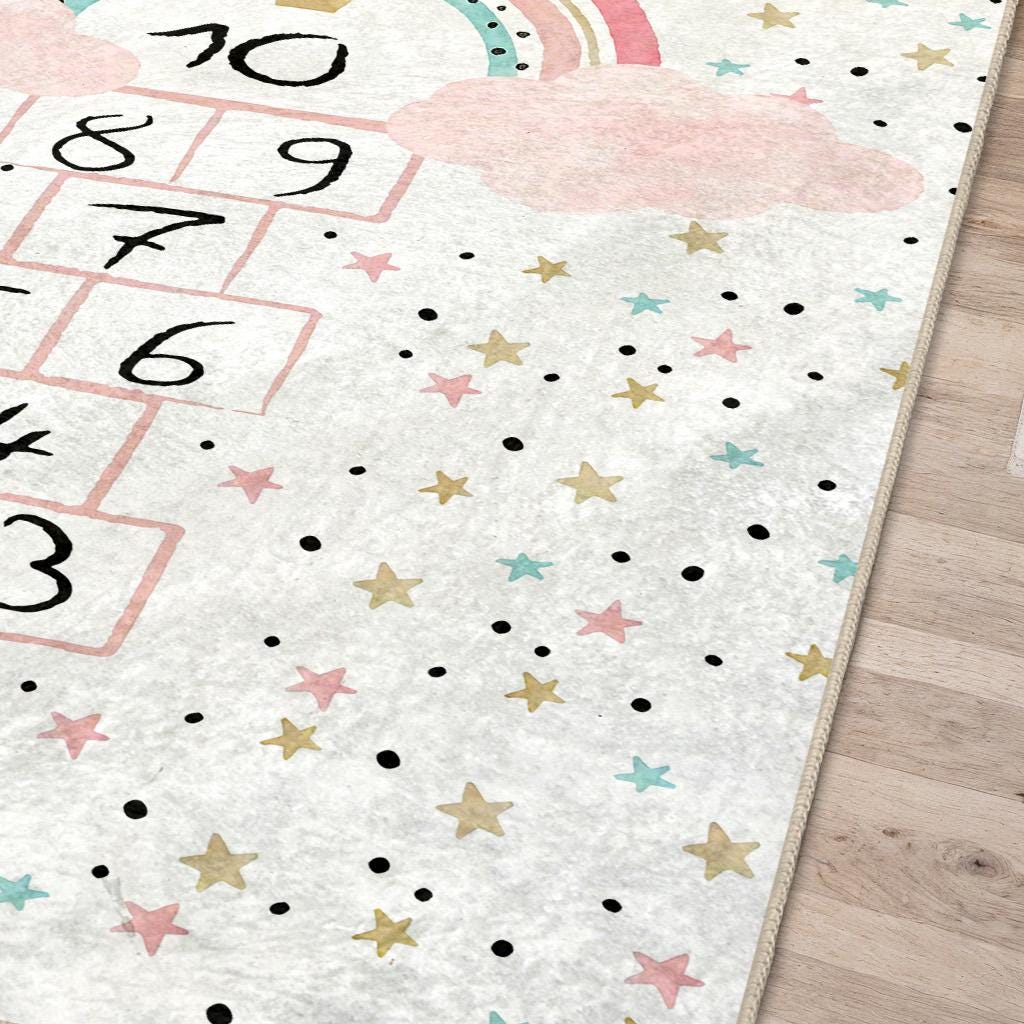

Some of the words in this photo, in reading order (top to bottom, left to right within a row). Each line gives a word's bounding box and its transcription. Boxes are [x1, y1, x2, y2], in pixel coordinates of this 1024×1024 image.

[147, 23, 348, 87] 10
[51, 114, 154, 172] 8
[273, 137, 353, 198] 9
[90, 203, 226, 270] 7
[118, 321, 235, 387] 6
